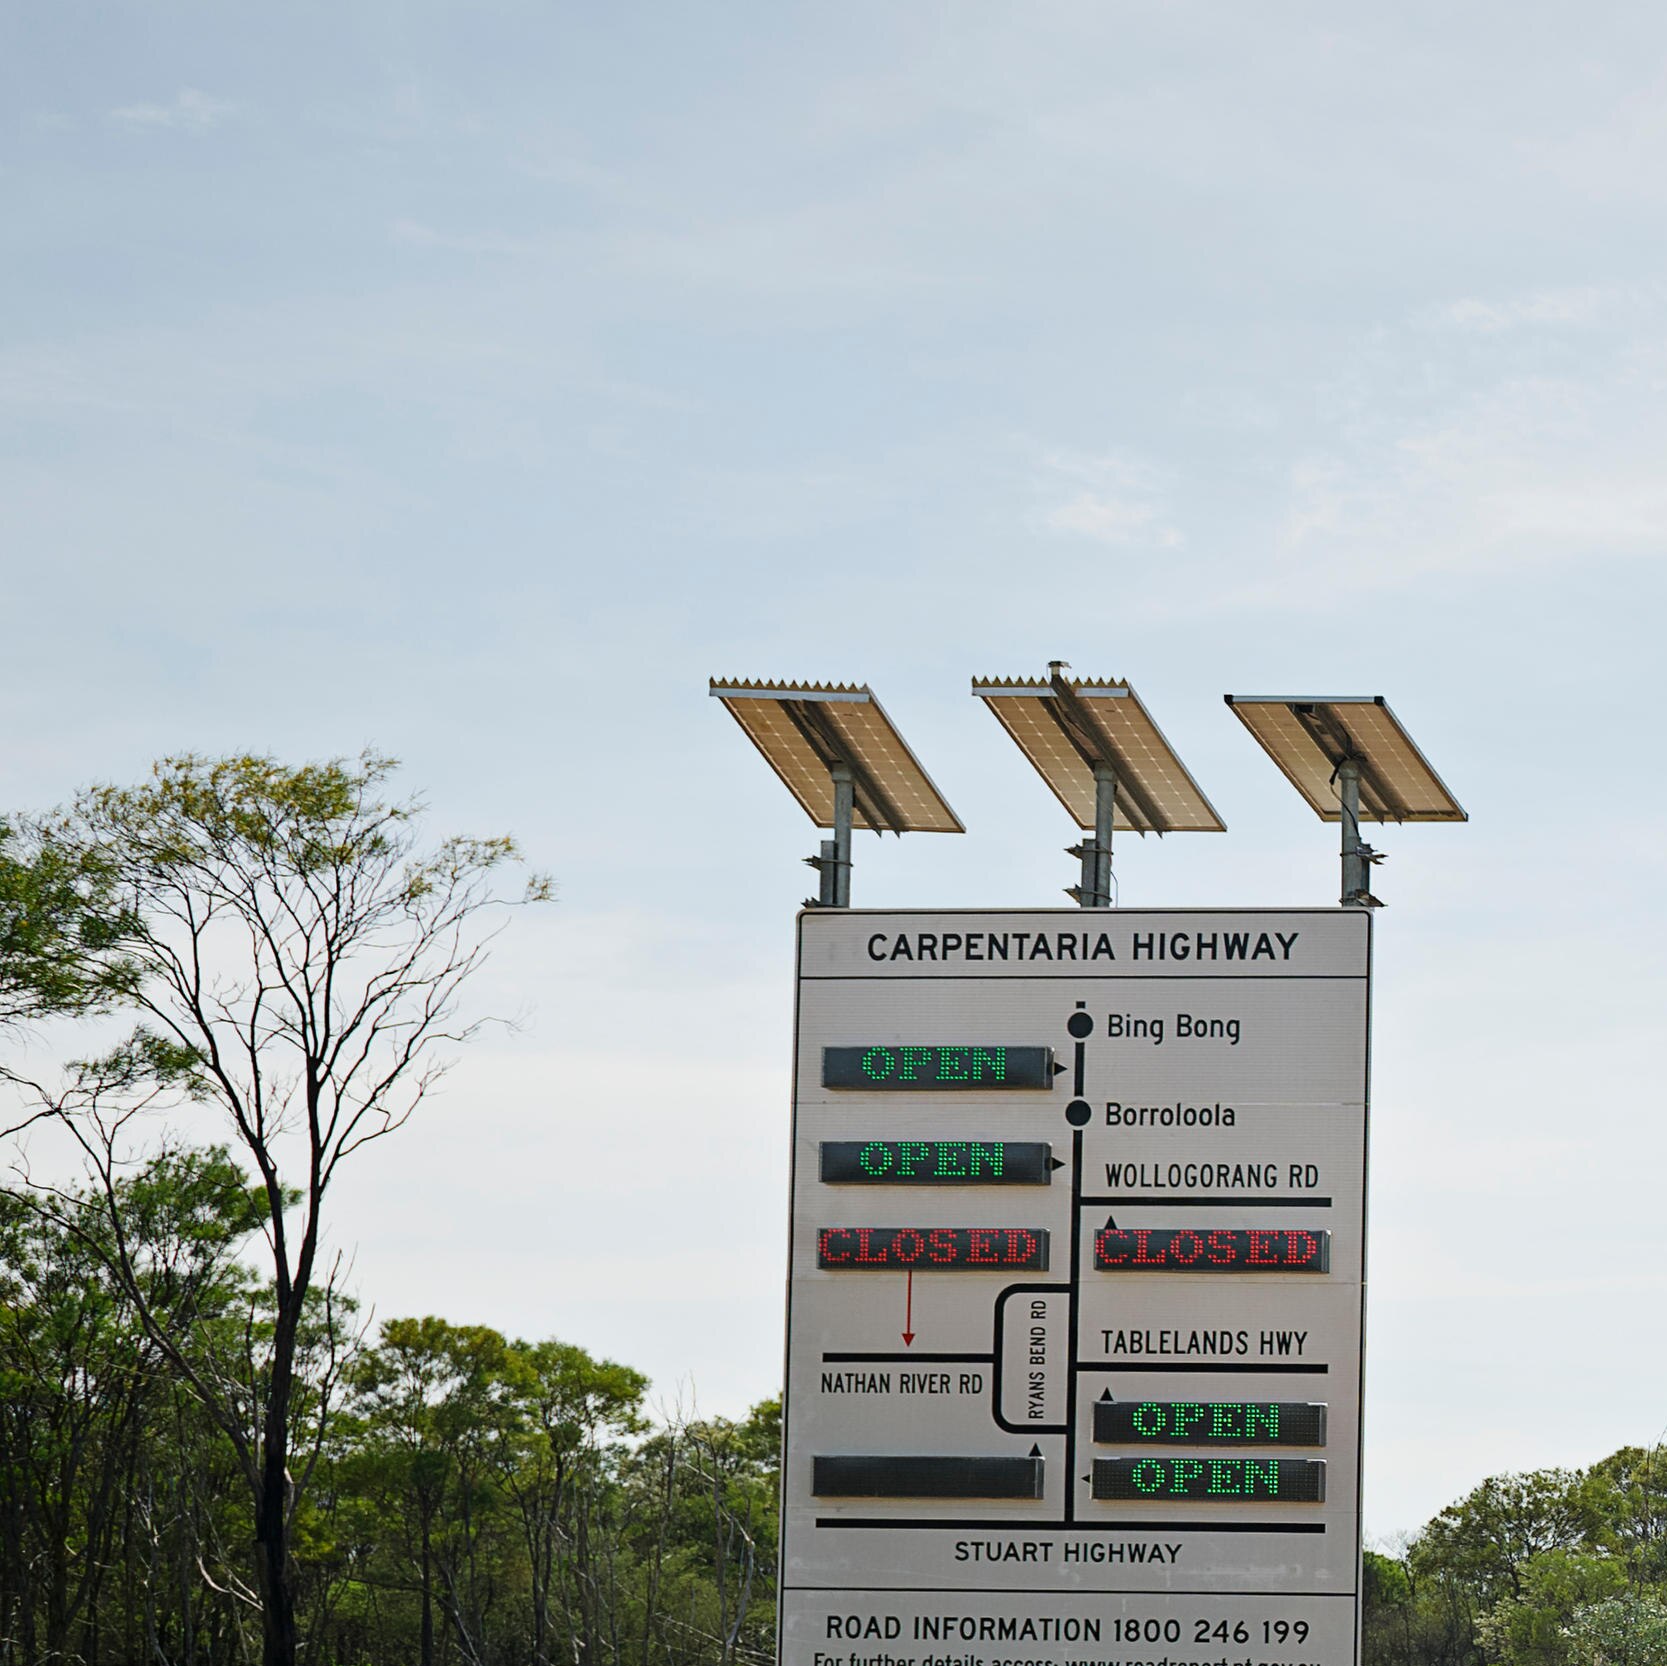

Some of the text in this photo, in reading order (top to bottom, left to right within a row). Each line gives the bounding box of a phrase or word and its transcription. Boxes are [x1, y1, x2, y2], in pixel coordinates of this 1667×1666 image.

[867, 932, 1299, 962] CARPENTARIA HIGHWAY
[1108, 1013, 1240, 1046] Bing Bong
[862, 1047, 1006, 1080] OPEN
[1105, 1102, 1235, 1127] Borroloola
[860, 1142, 1004, 1176] OPEN
[1105, 1163, 1319, 1188] WOLLOGORANG RD
[819, 1228, 1037, 1263] CLOSED
[1095, 1229, 1317, 1264] CLOSED
[1101, 1329, 1308, 1356] TABLELANDS HWY
[1028, 1300, 1047, 1419] RYANS BEND RD
[821, 1372, 983, 1395] NATHAN RIVER RD
[1132, 1402, 1279, 1438] OPEN
[1132, 1459, 1279, 1494] OPEN
[954, 1541, 1183, 1564] STUART HIGHWAY
[826, 1615, 1310, 1645] ROAD INFORMATION 1800 246 199
